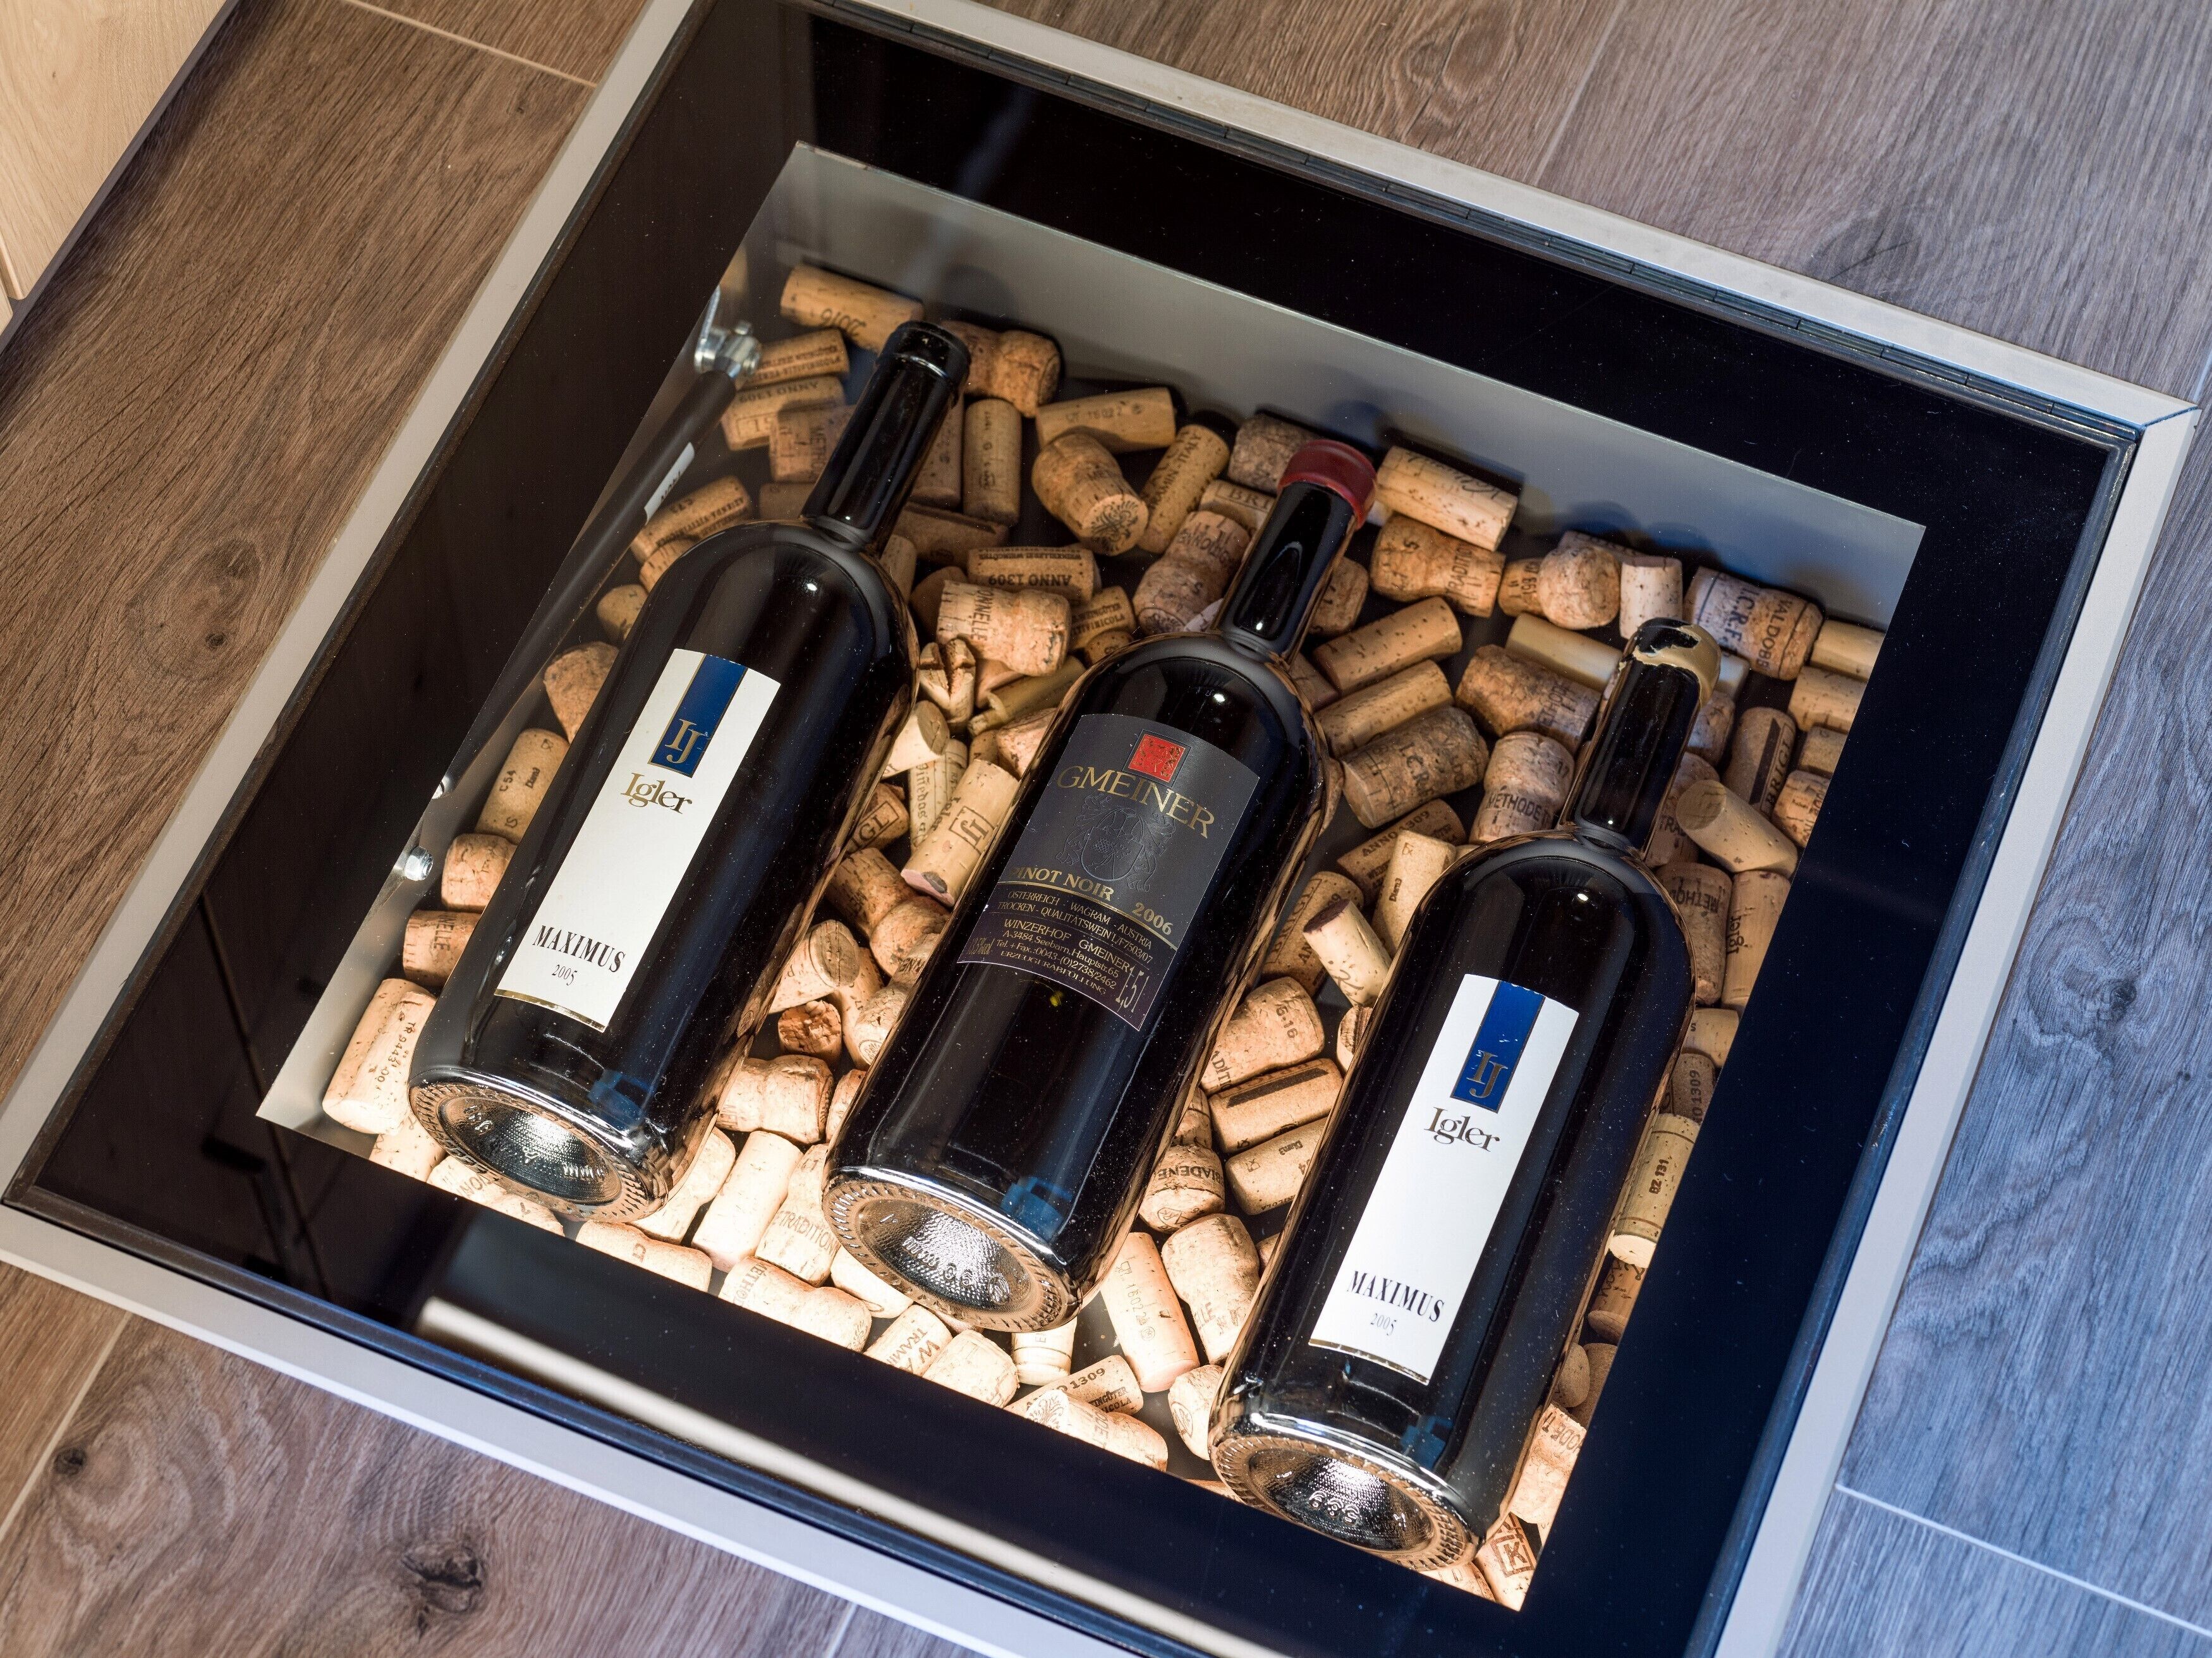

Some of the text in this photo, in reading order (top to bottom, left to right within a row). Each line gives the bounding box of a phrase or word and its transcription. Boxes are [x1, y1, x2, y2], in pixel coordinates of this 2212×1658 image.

[987, 573, 1073, 588] ANNO 1309
[620, 772, 693, 815] Igler
[1056, 765, 1215, 839] GMEINER
[1011, 866, 1114, 902] PINOT NOIR
[998, 901, 1036, 913] TROCKEN
[1131, 902, 1174, 936] 2006
[996, 939, 1009, 948] Tel.
[1071, 902, 1112, 925] WAGRAM
[1117, 923, 1152, 950] AUSTRIA
[532, 925, 626, 973] MAXIMUS
[1004, 918, 1131, 973] WINZERHOF GMEINER
[550, 964, 578, 986] 2005
[1689, 1070, 1703, 1106] 1309
[1423, 1106, 1500, 1152] Igler
[1346, 1270, 1445, 1322] MAXIMUS
[1370, 1312, 1398, 1336] 2005
[1069, 1367, 1106, 1390] 1309
